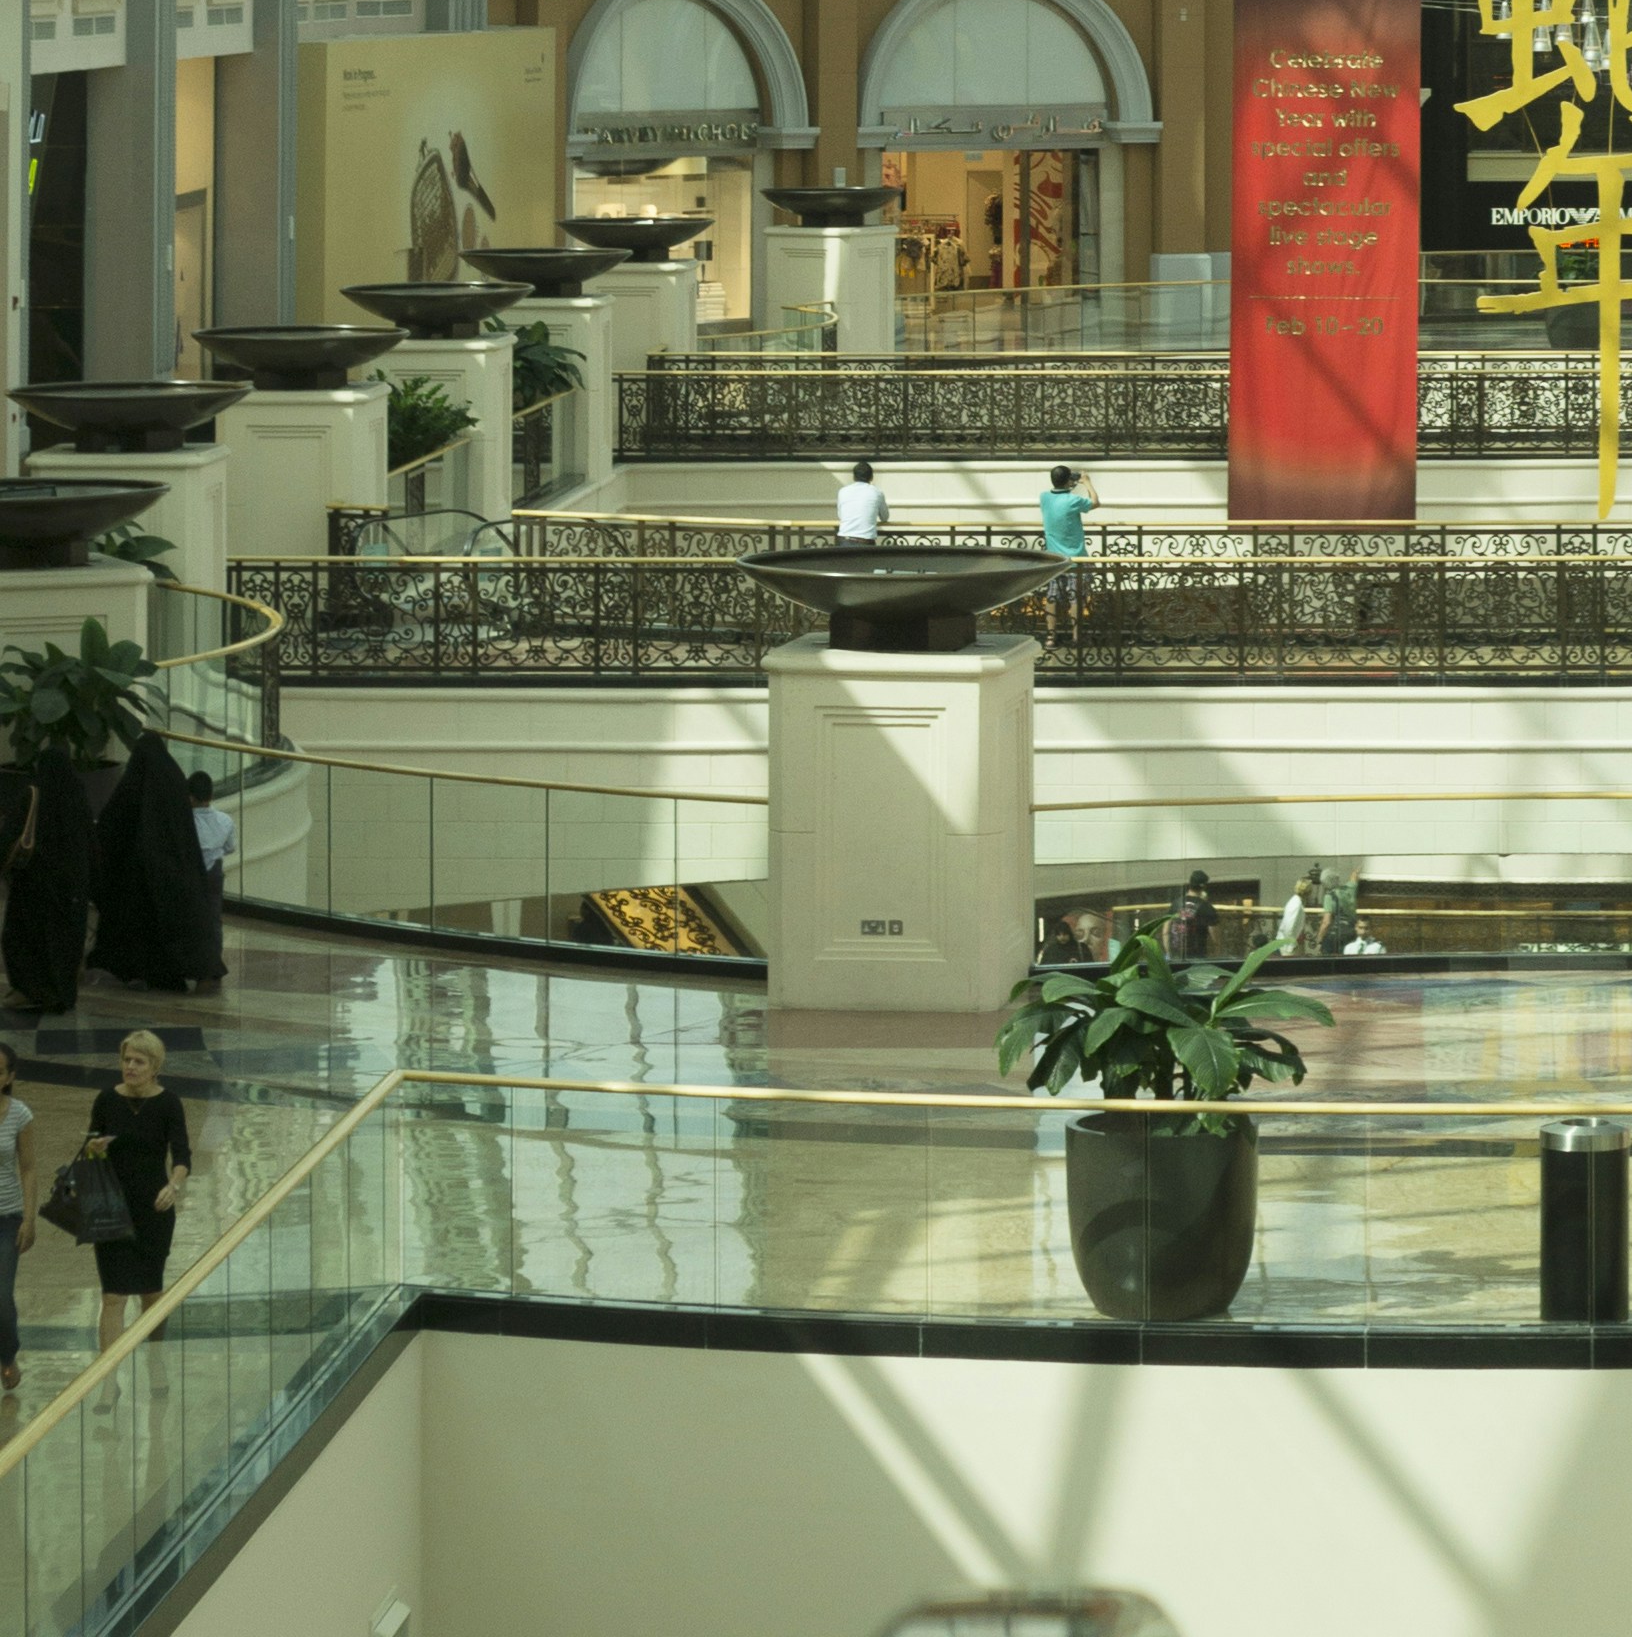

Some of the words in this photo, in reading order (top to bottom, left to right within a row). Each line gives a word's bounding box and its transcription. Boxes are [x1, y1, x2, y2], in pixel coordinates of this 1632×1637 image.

[1269, 49, 1384, 69] Celebrate
[1253, 78, 1344, 98] Chinese
[1350, 79, 1400, 98] New
[1275, 108, 1325, 128] Year
[1332, 109, 1377, 128] with
[1252, 137, 1333, 160] special
[1339, 138, 1400, 158] offers
[1303, 169, 1348, 187] and
[1258, 197, 1392, 219] spectacular
[1491, 208, 1570, 225] EMPORIO
[1269, 226, 1309, 245] live
[1316, 227, 1379, 250] stage
[1287, 256, 1361, 275] shows.
[1265, 317, 1306, 335] Feb
